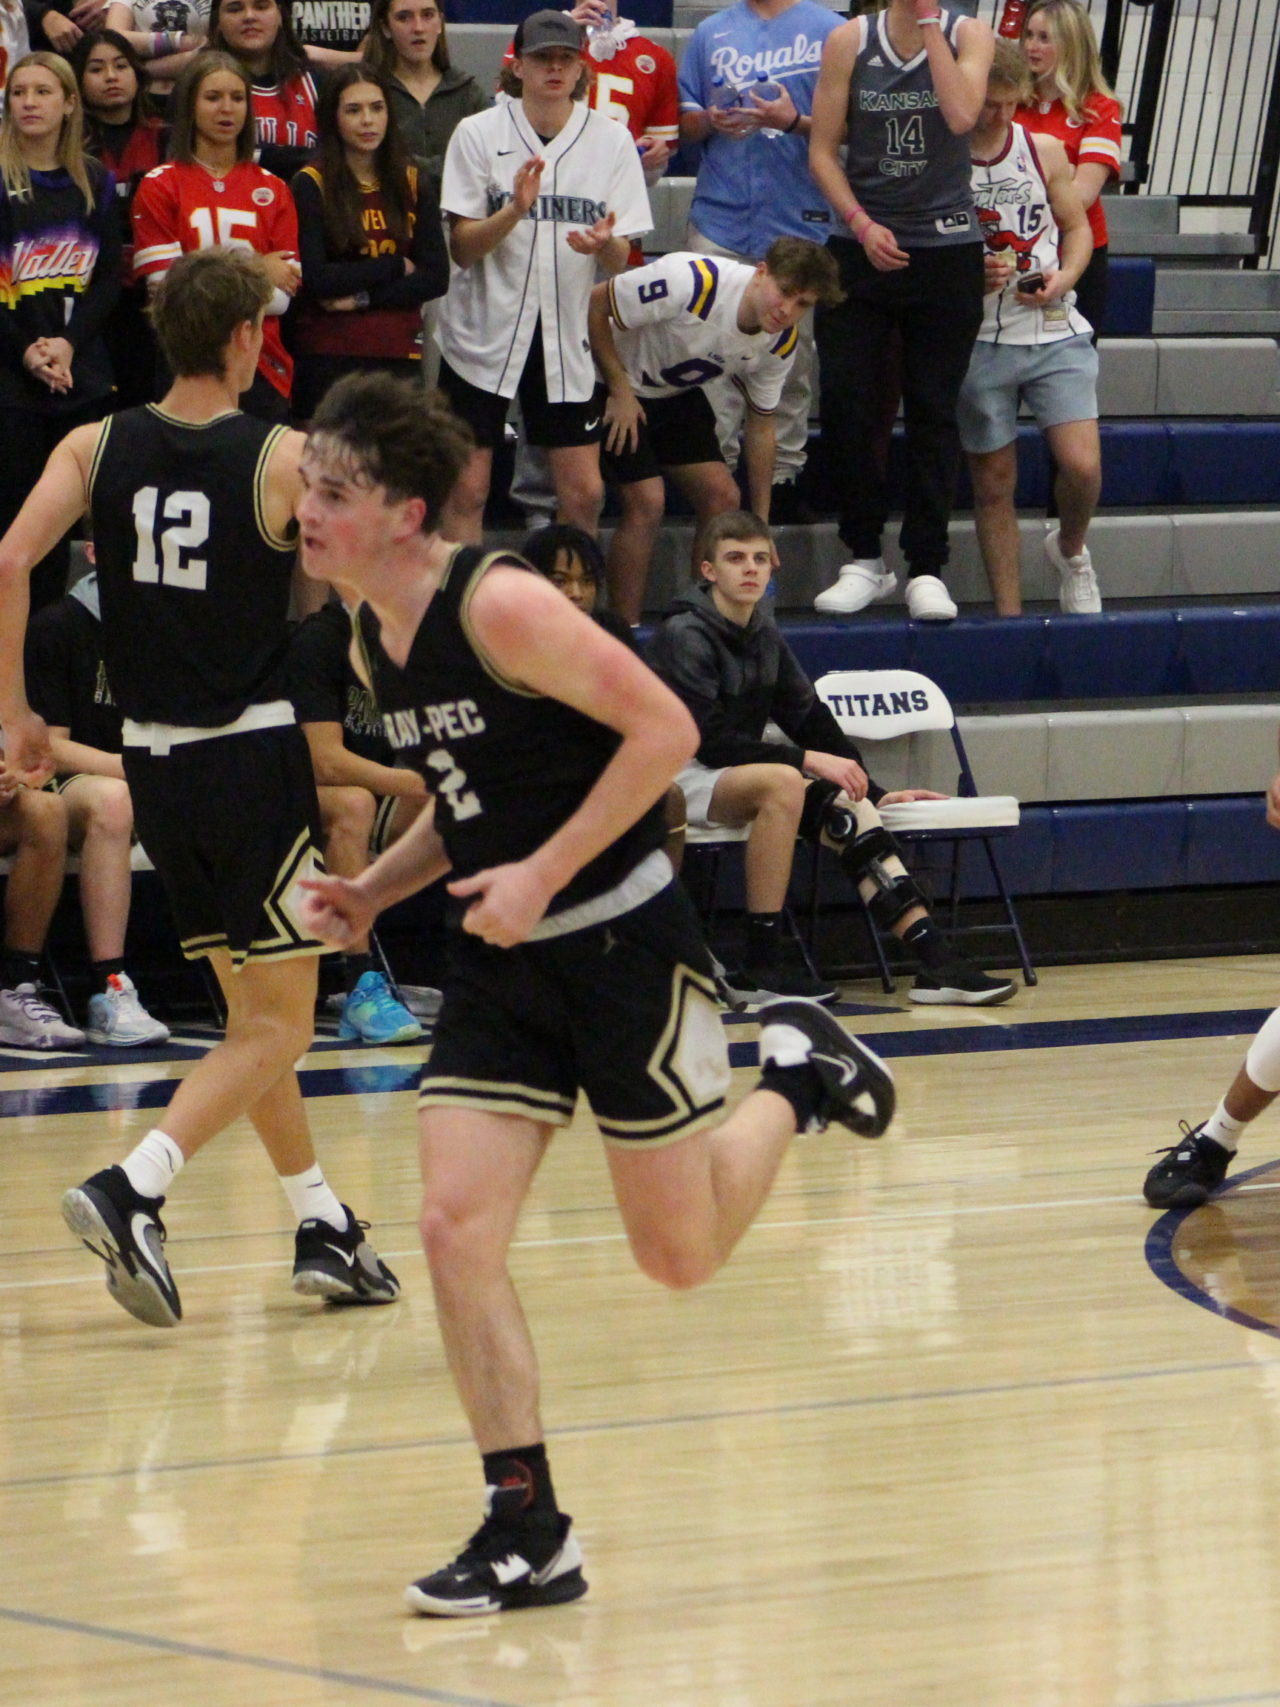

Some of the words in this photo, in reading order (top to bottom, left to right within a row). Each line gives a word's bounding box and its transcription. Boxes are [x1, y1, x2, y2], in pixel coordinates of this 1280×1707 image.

[711, 33, 823, 84] Royals
[886, 115, 925, 155] 14
[879, 158, 928, 178] CITY
[189, 207, 257, 251] 15
[1017, 204, 1045, 234] 15
[11, 239, 100, 286] Valley
[638, 279, 669, 304] 9
[132, 485, 211, 591] 12
[827, 689, 930, 718] TITANS
[426, 748, 483, 822] 2
